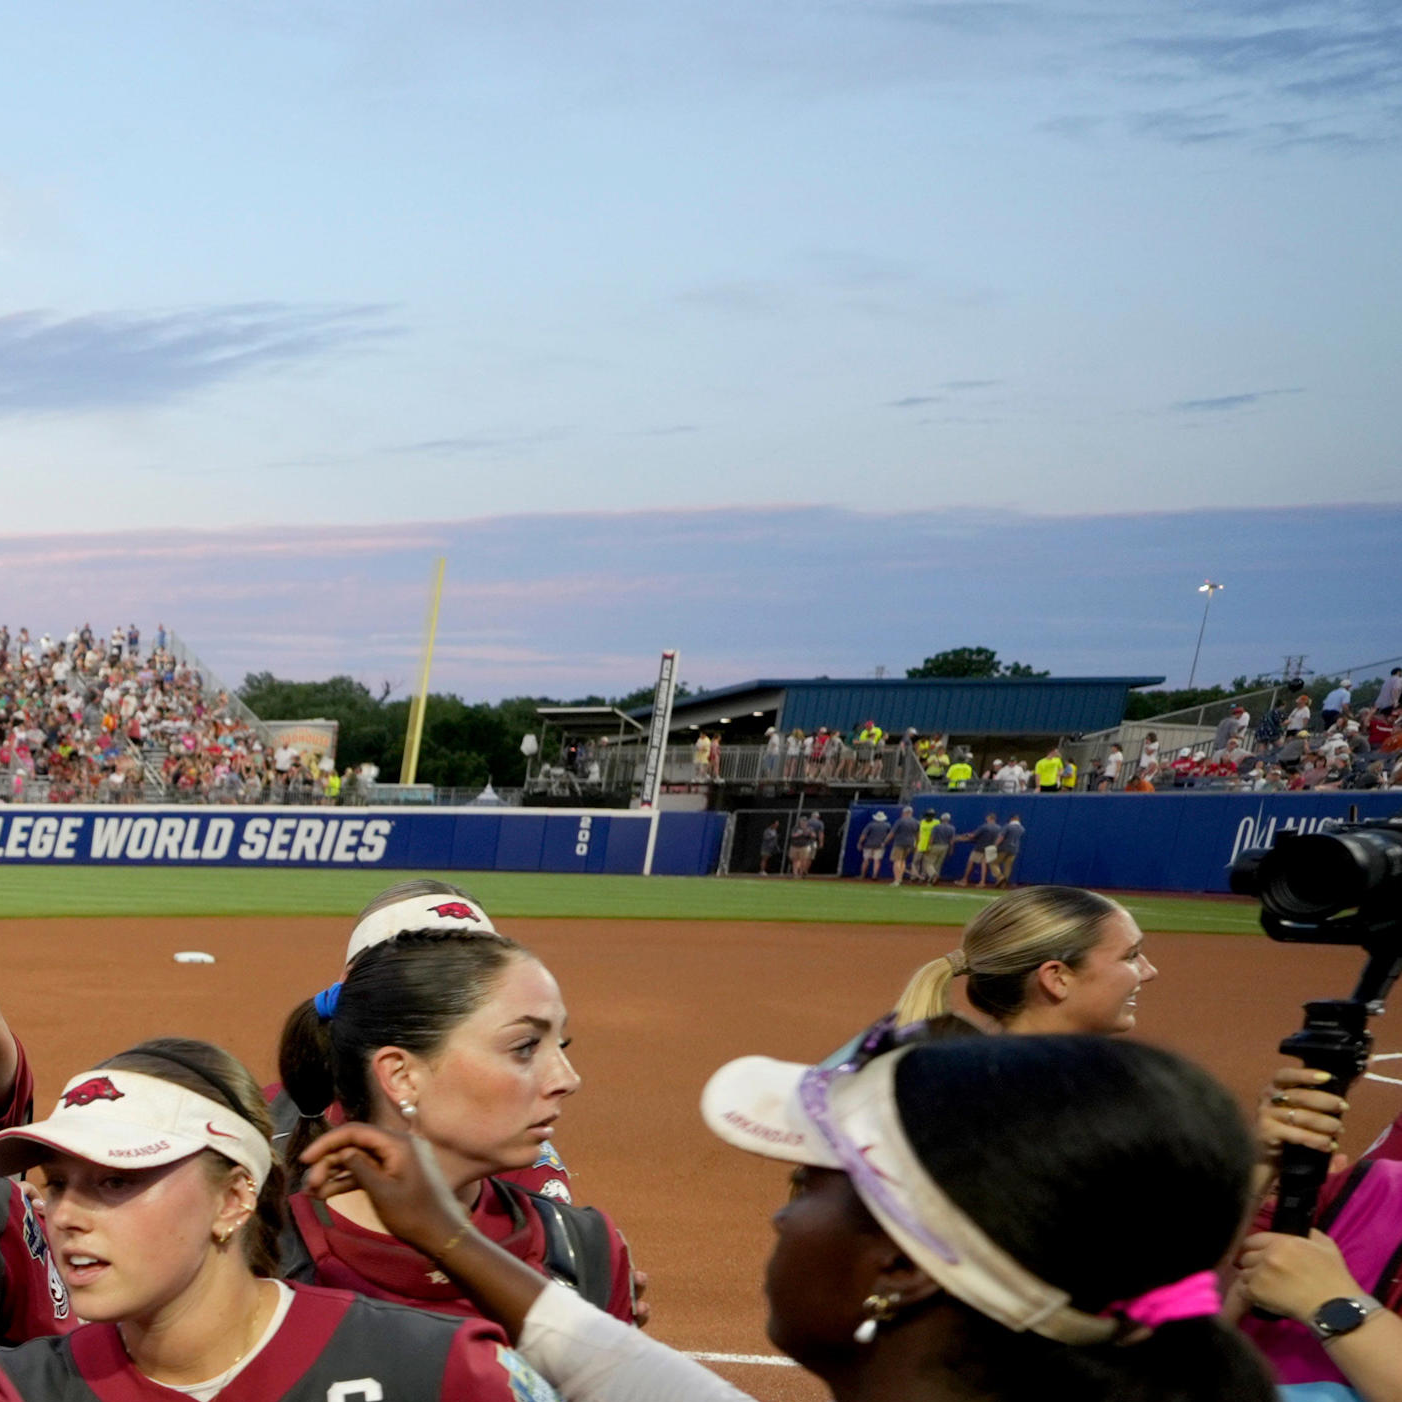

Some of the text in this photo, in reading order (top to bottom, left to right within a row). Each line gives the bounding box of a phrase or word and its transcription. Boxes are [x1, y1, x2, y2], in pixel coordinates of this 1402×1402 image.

[90, 817, 235, 859] WORLD
[238, 818, 392, 862] SERIES
[108, 1139, 171, 1159] ARKANSAS
